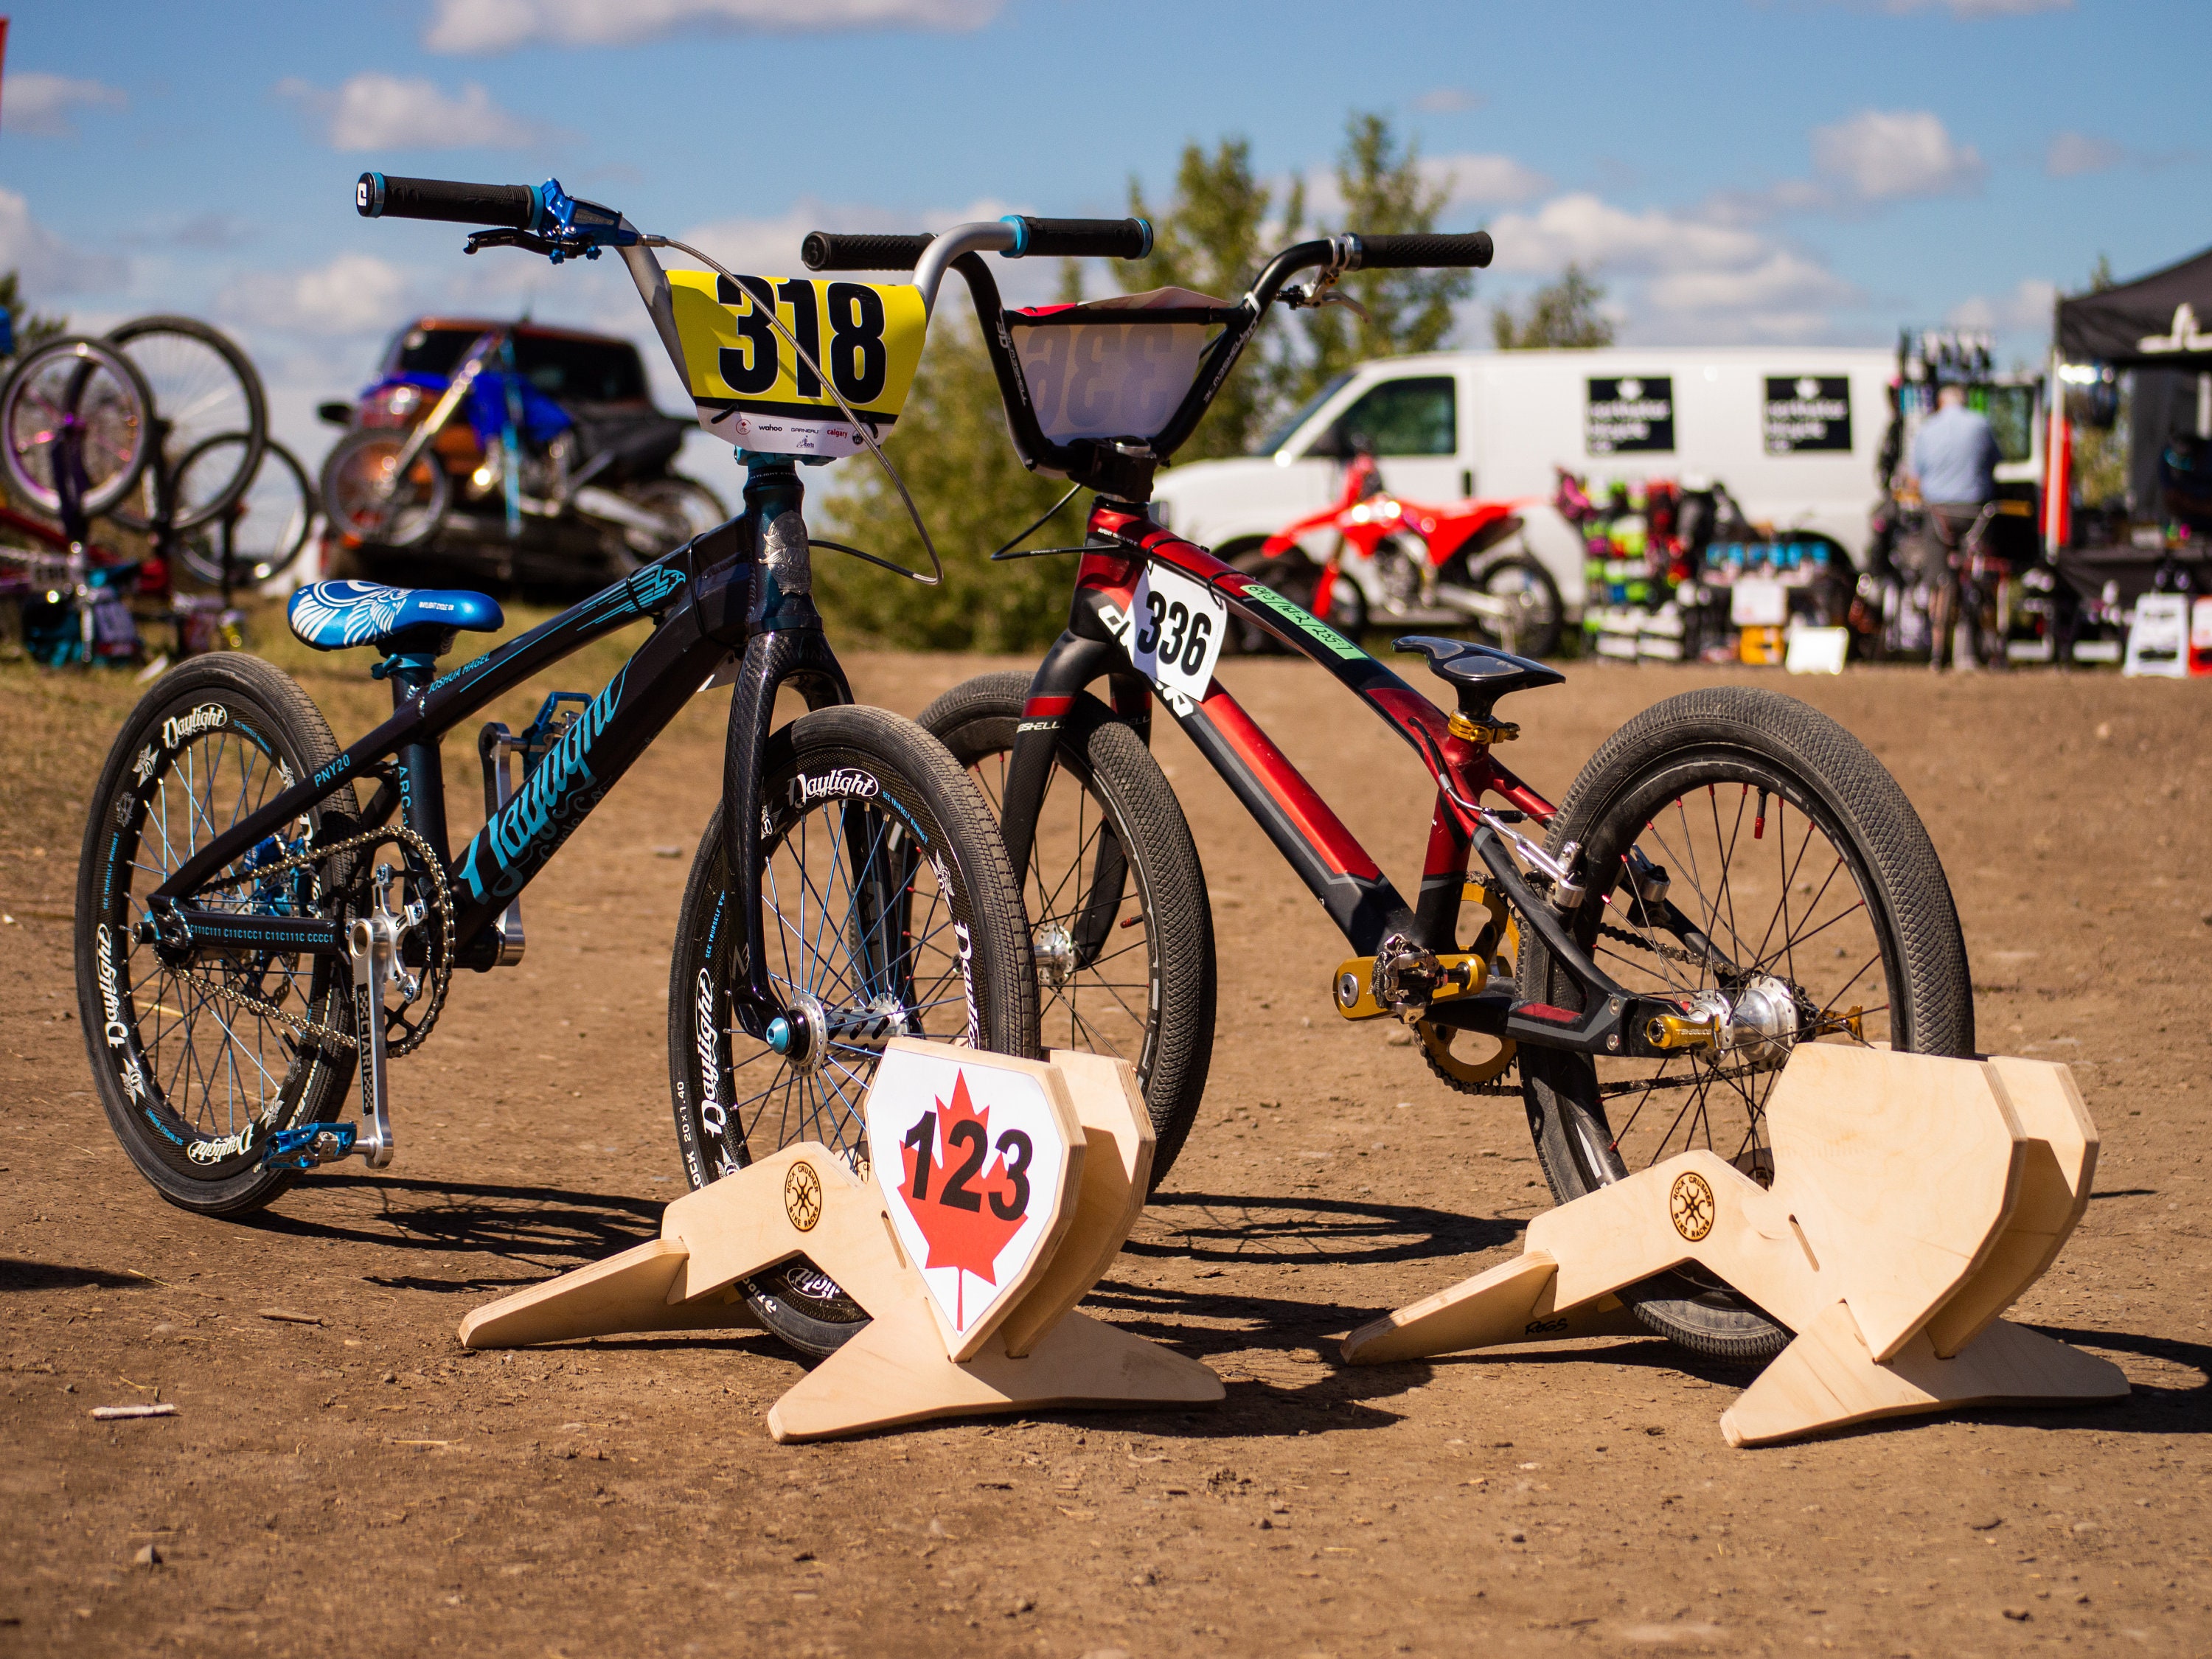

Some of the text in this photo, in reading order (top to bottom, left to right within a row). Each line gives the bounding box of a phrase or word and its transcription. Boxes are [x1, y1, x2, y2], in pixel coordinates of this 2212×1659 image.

[716, 273, 887, 405] 318
[758, 424, 783, 432] wahoo
[827, 428, 848, 439] calgary
[1137, 591, 1212, 676] 336
[428, 652, 491, 695] JOSHUA HAGEL
[162, 703, 228, 749] Daylight
[314, 754, 350, 788] PNY20
[399, 766, 411, 810] ARC
[785, 768, 879, 809] Daylight
[883, 791, 891, 802] SEE
[891, 798, 911, 821] YOURSELF
[709, 907, 721, 943] YOURSELF
[97, 923, 128, 1048] Daylight
[954, 919, 979, 1050] Daylig
[361, 1020, 372, 1074] CIARI
[695, 967, 727, 1138] Daylight
[187, 1123, 254, 1166] Daylight
[904, 1110, 1033, 1222] 123
[787, 1166, 819, 1194] ROCK CRUSHER
[1673, 1176, 1711, 1207] ROCK CRUSHER
[789, 1206, 818, 1228] BIKE RACKS
[1674, 1212, 1710, 1238] BIKE RACKS
